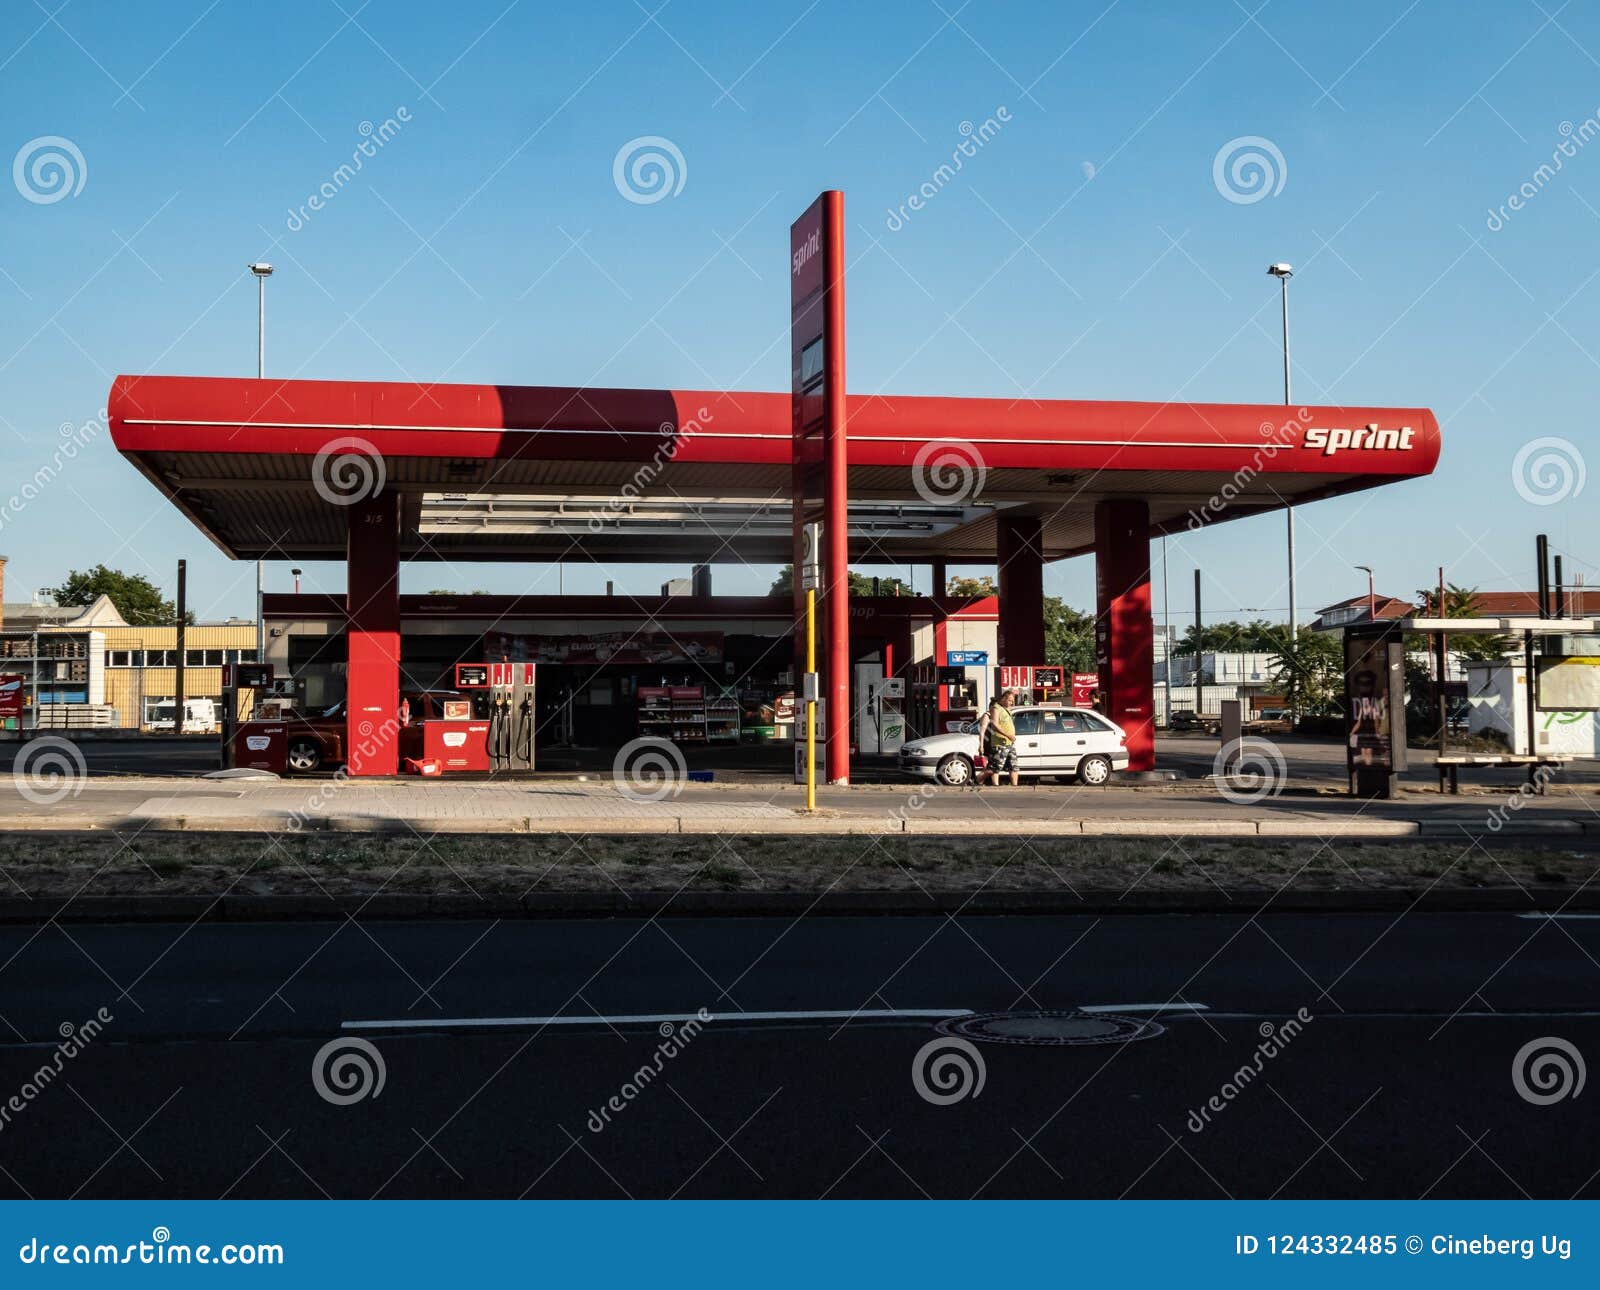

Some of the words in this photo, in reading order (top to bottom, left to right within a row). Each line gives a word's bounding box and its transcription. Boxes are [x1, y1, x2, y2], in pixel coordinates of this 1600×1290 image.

[792, 227, 821, 276] sprint
[1304, 423, 1416, 455] sprint
[848, 604, 875, 621] hop
